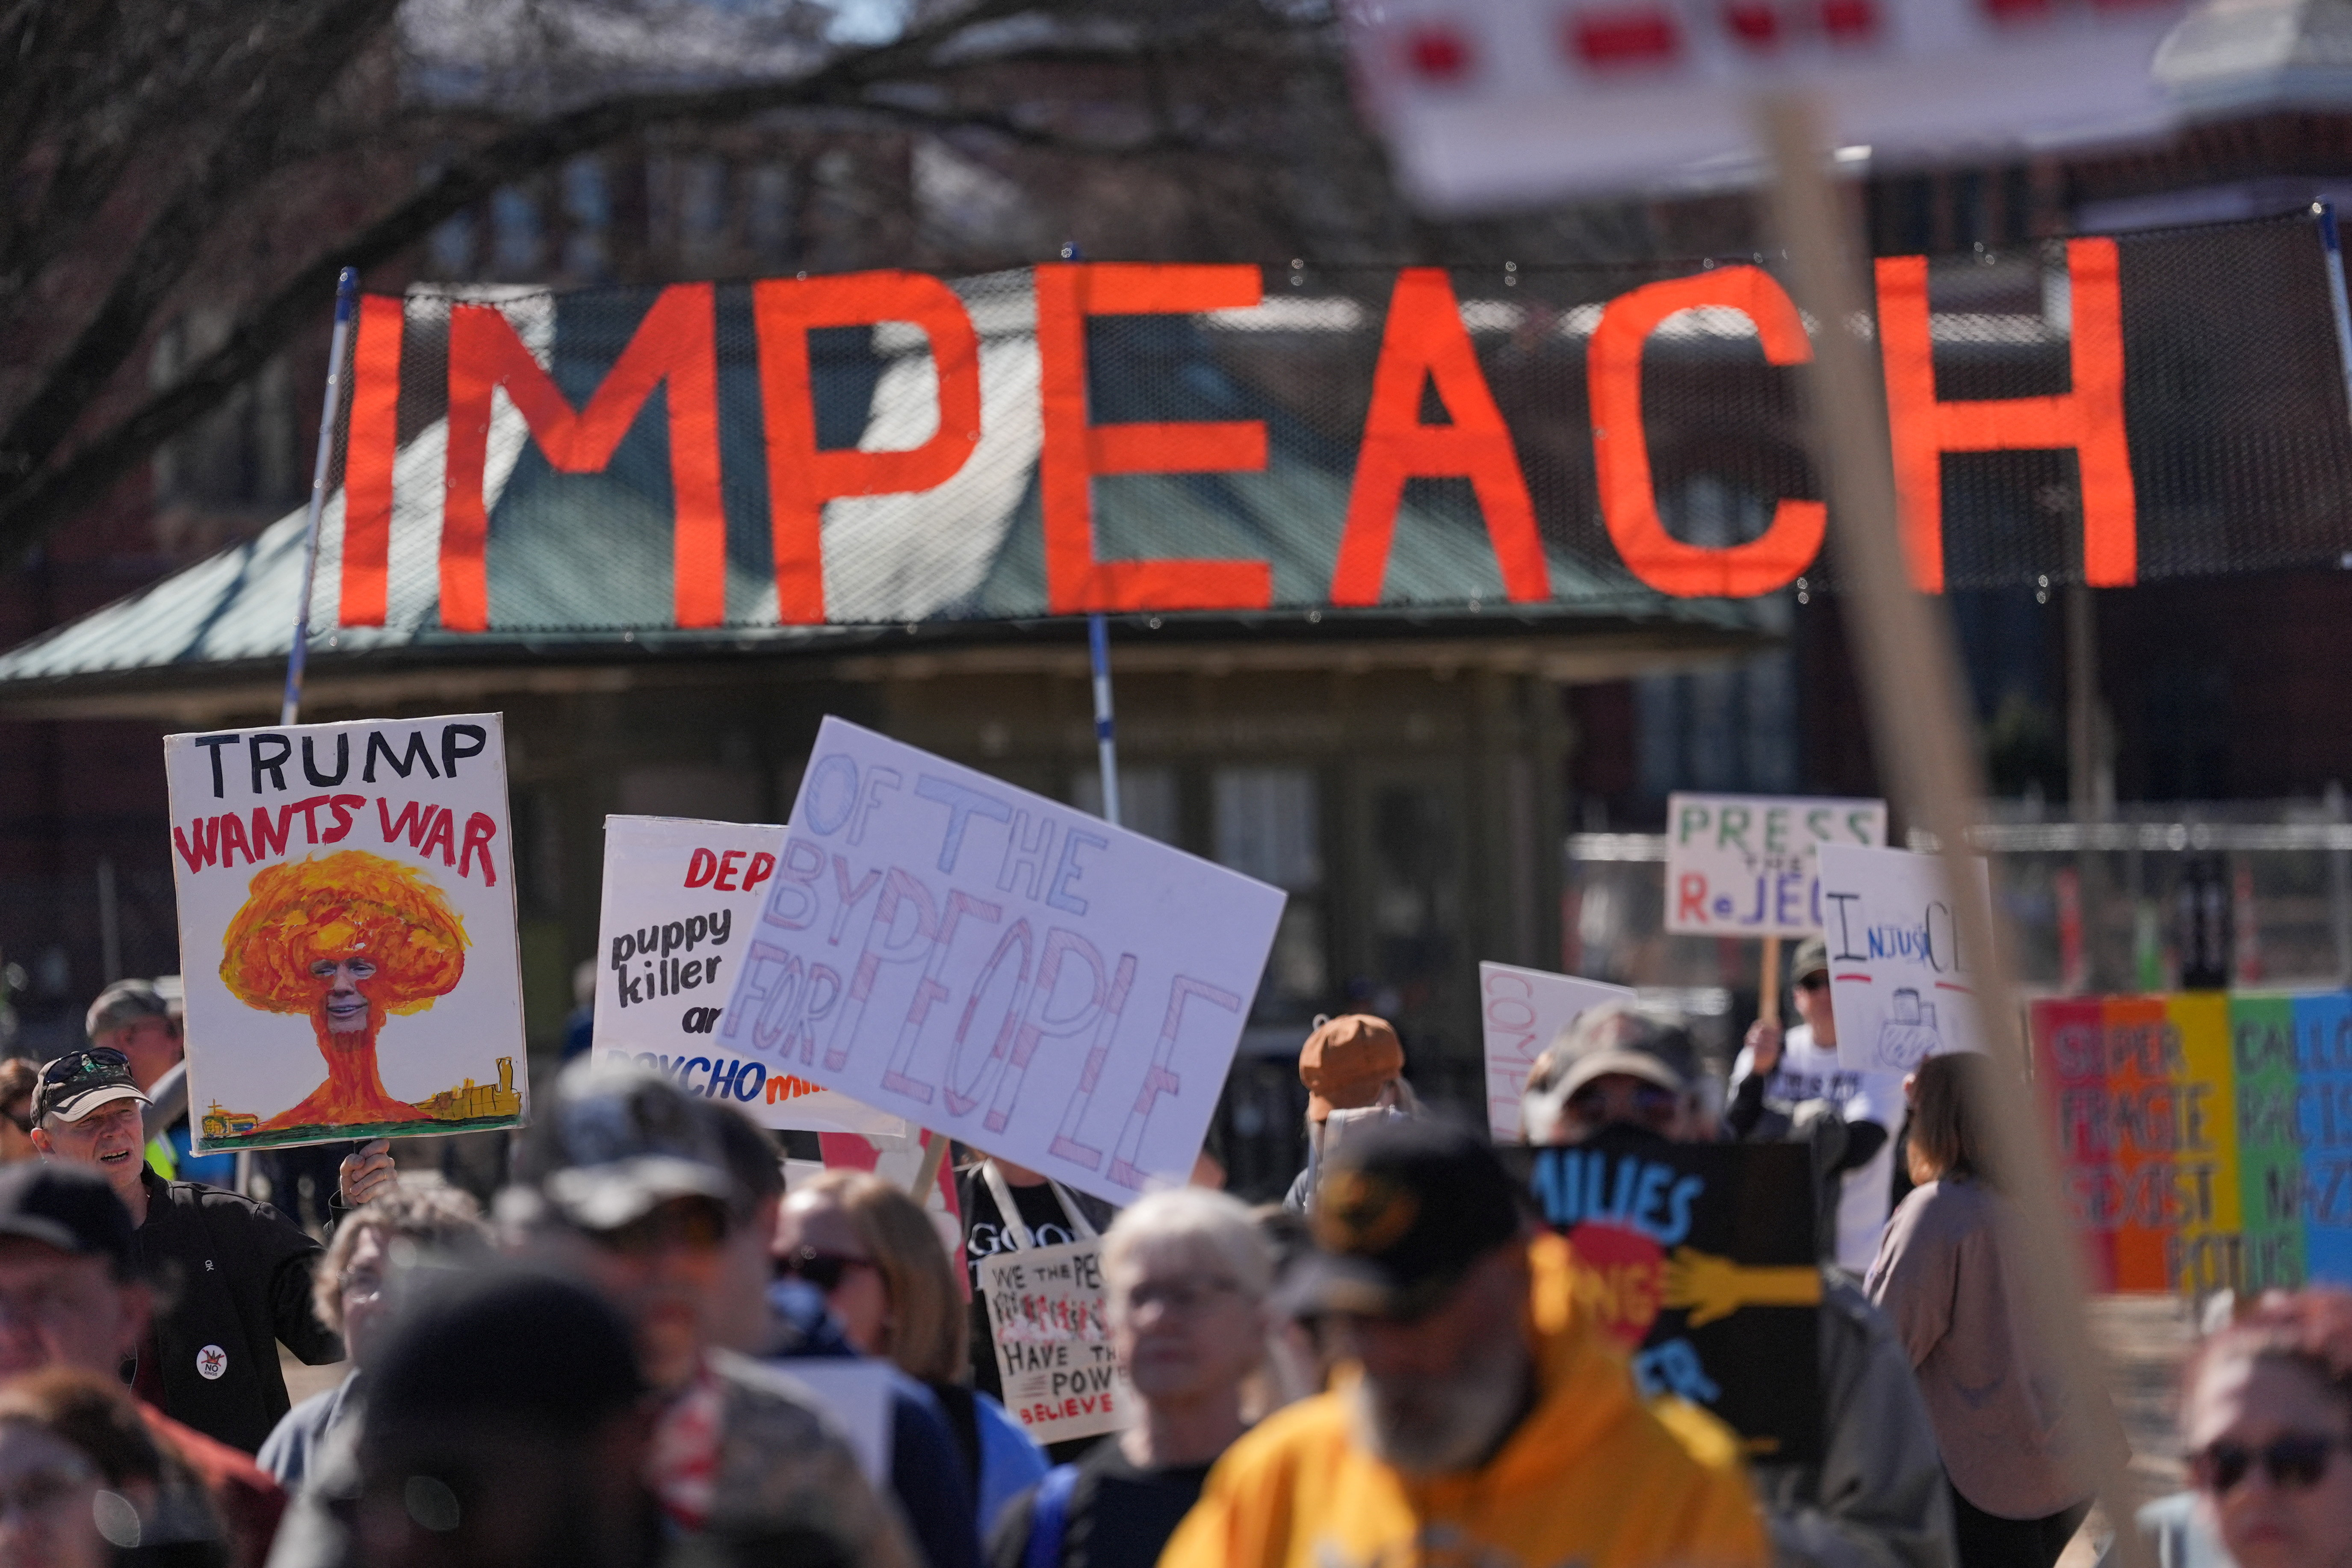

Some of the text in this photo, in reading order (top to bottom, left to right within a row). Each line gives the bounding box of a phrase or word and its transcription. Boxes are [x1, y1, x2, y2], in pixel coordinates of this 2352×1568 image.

[340, 237, 2137, 632] IMPEACH
[195, 724, 487, 799] TRUMP
[174, 794, 496, 887] WANTS WAR
[804, 753, 1108, 915] OF THE
[1678, 803, 1874, 855] PRESS
[611, 909, 732, 970] puppy
[618, 956, 722, 1008] killer
[723, 941, 842, 1067] FOR
[763, 838, 1241, 1193] BY PEOPLE
[992, 1264, 1025, 1289] WE
[1034, 1264, 1070, 1281] THE
[205, 1364, 218, 1372] NO
[1002, 1341, 1068, 1376] HAVE
[1020, 1392, 1113, 1425] BELIEVE
